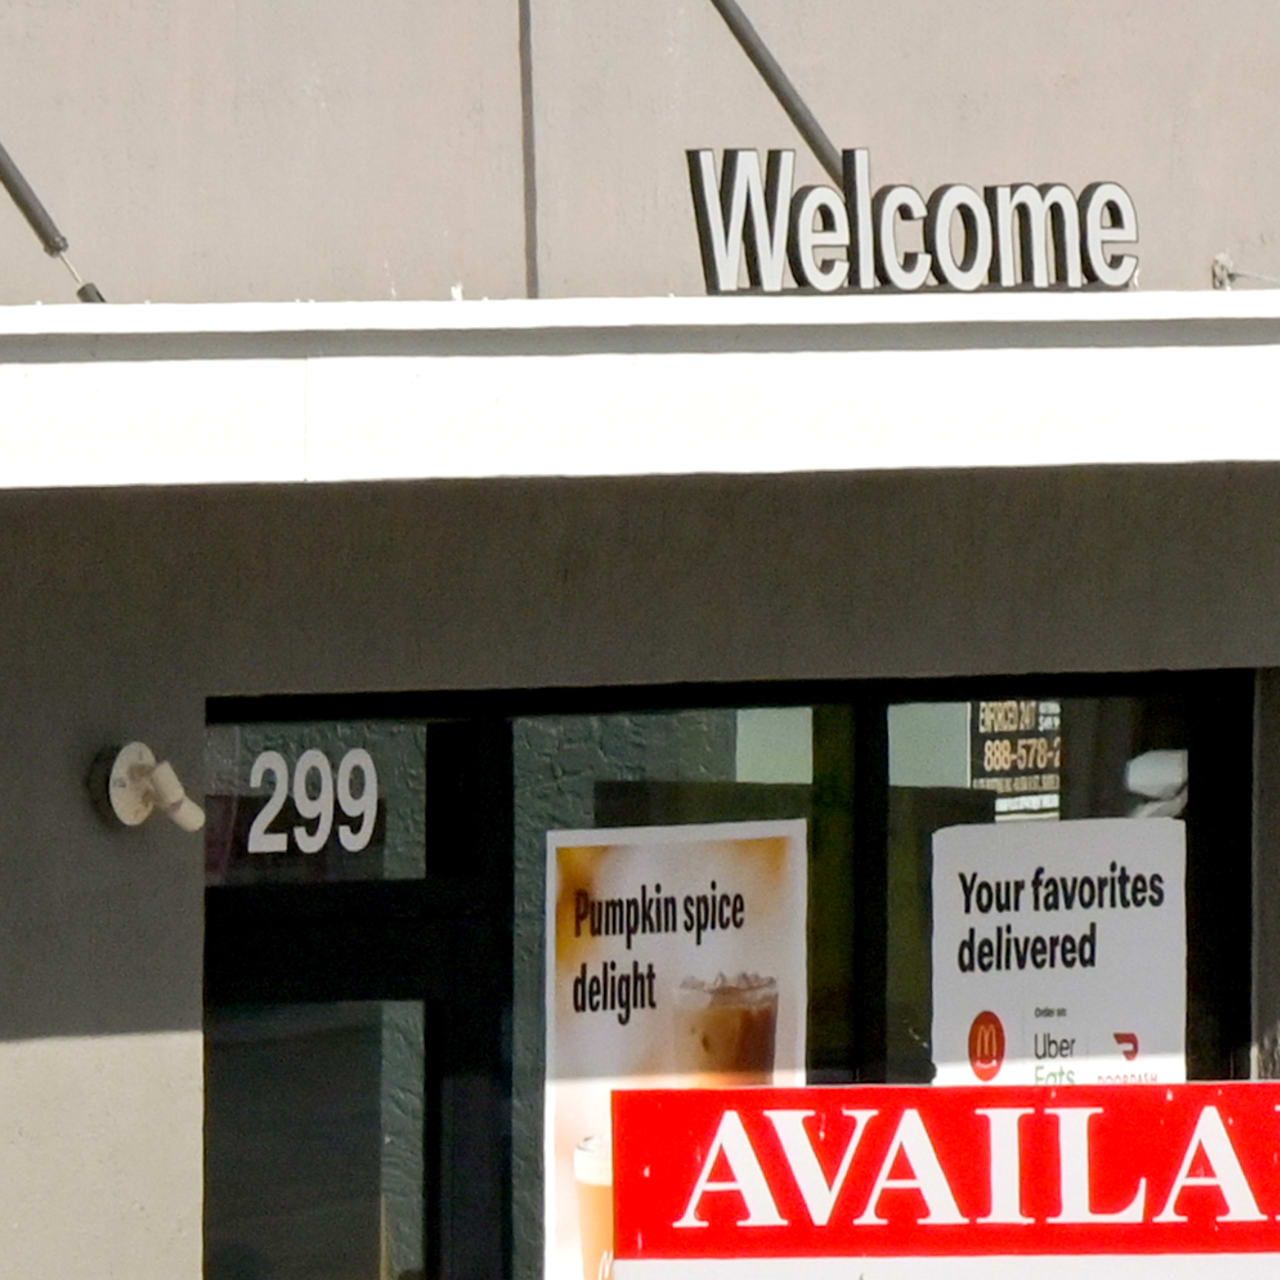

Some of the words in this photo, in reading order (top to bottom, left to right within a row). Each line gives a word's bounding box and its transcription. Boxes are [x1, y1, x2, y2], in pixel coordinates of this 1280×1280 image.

[689, 148, 1139, 292] Welcome
[247, 747, 379, 854] 299
[574, 883, 678, 950] Pumpkin
[683, 880, 745, 946] spice
[958, 872, 1025, 915] Your
[1031, 860, 1165, 912] favorites
[957, 922, 1097, 973] delivered
[572, 960, 657, 1026] delight
[1033, 1032, 1076, 1060] Uber
